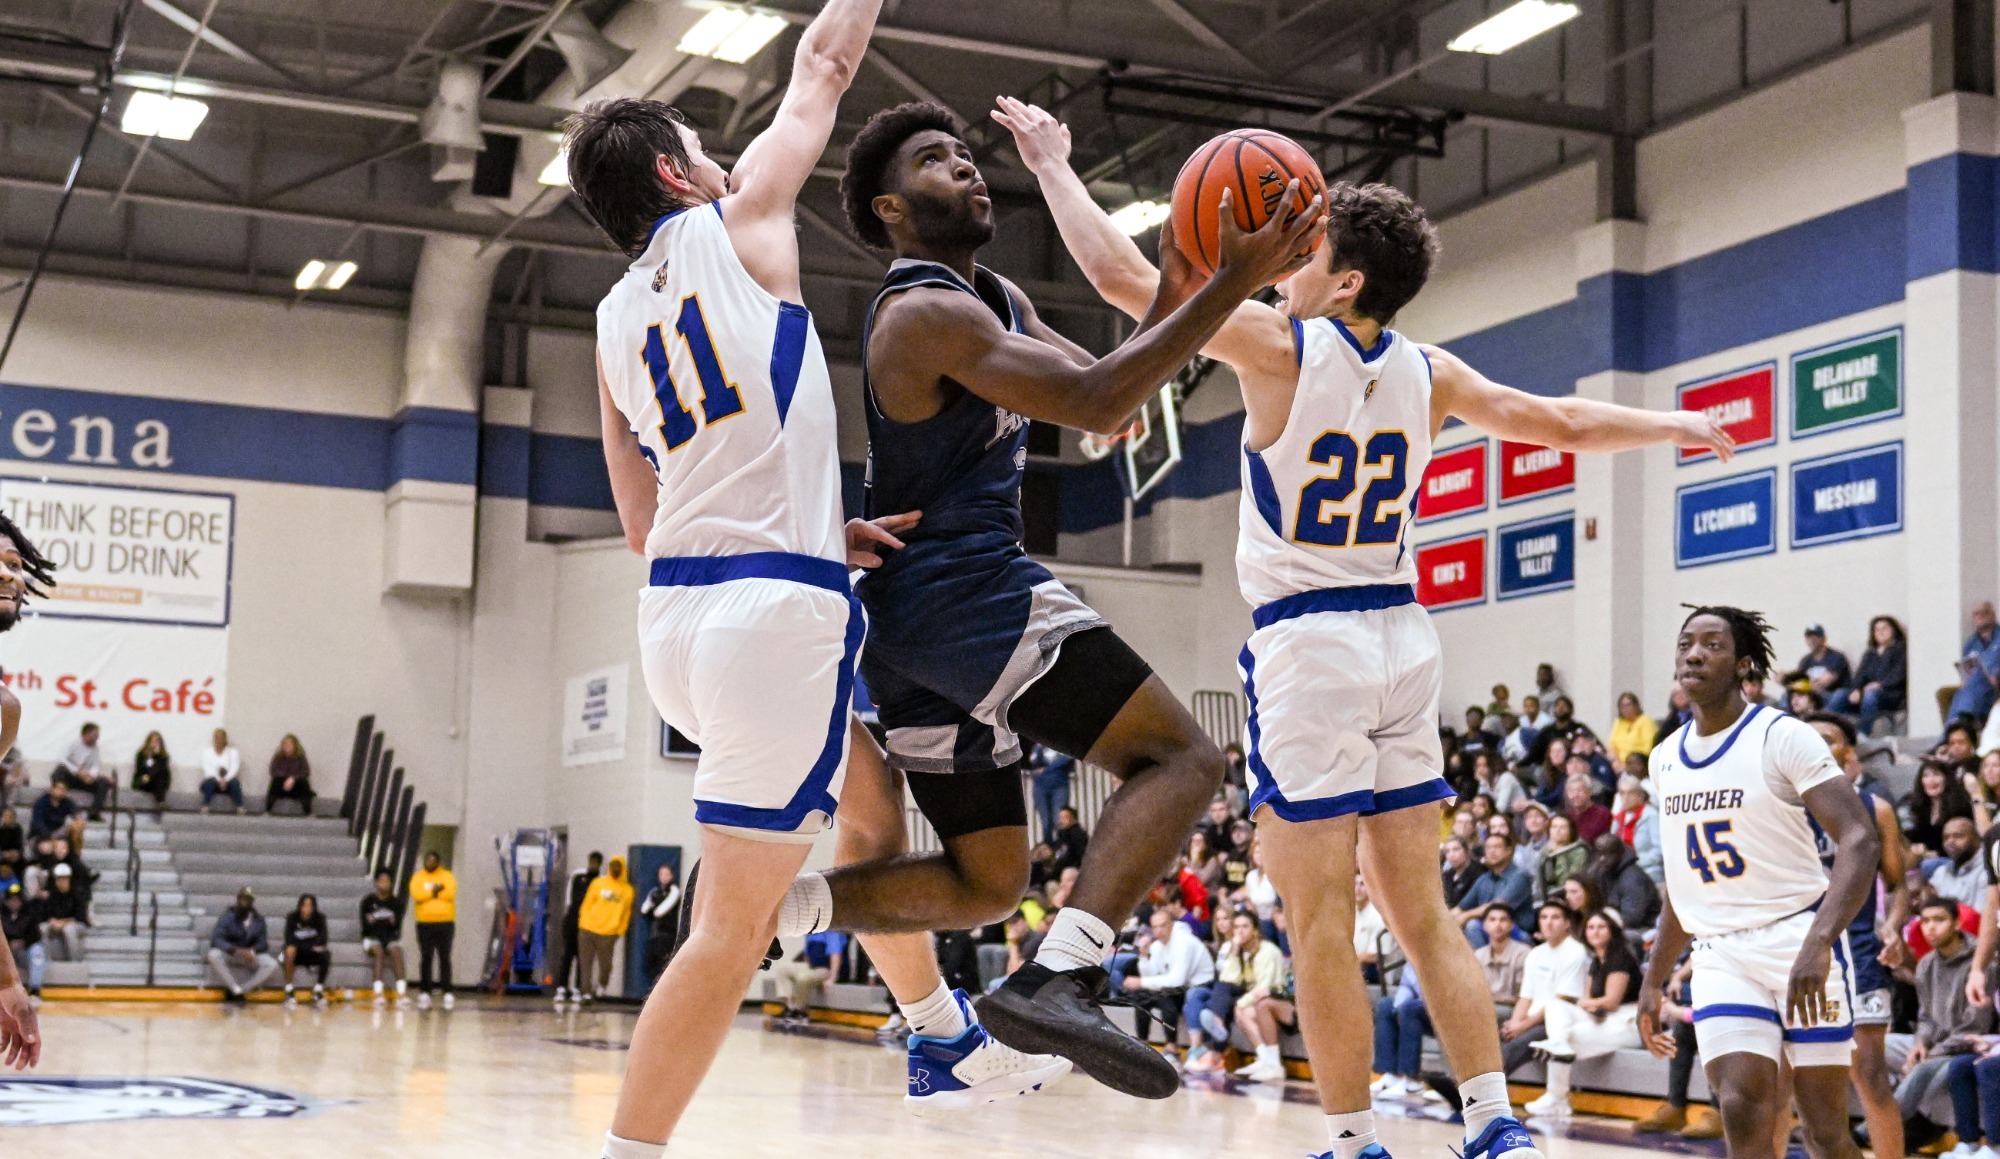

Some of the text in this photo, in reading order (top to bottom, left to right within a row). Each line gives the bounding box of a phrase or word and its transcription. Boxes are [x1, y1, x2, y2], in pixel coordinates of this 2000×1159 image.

[1258, 168, 1287, 217] OCK
[640, 291, 747, 455] 11
[1813, 353, 1879, 391] DELAWARE
[1822, 379, 1868, 410] VALLEY
[0, 408, 174, 469] ena
[1291, 429, 1410, 548] 22
[1814, 478, 1878, 513] MESSIAH
[110, 505, 224, 545] BEFORE
[1693, 501, 1758, 535] LYCOMING
[107, 542, 200, 579] DRINK
[1516, 534, 1559, 559] LEBANON
[1519, 554, 1554, 578] VALLEY
[54, 673, 109, 710] St.
[121, 676, 216, 715] Café
[1665, 789, 1744, 816] GOUCHER
[1686, 819, 1747, 884] 45
